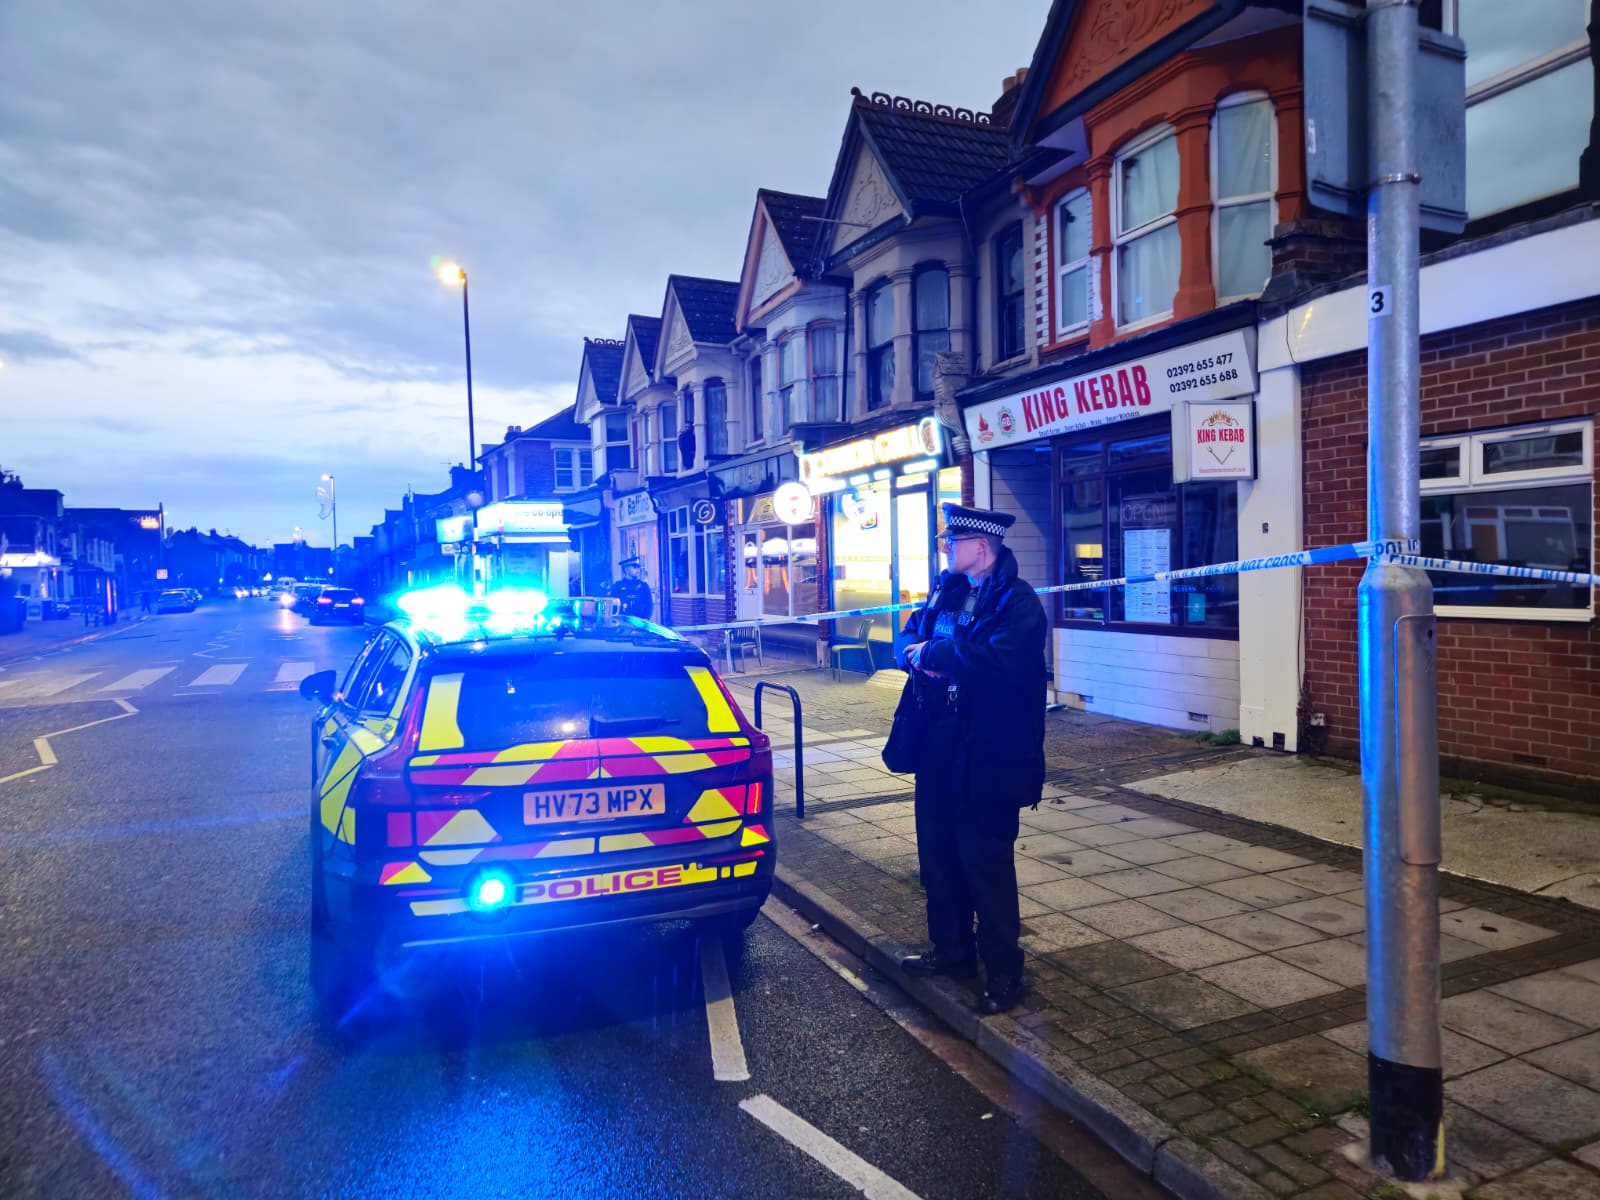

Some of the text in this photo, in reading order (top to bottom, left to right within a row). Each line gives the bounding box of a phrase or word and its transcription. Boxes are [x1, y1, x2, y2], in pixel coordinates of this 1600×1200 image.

[1371, 291, 1384, 313] 3
[1166, 352, 1233, 378] 02392 655 477
[1169, 368, 1238, 393] 02392 655 688
[1021, 387, 1069, 432] KING
[1073, 365, 1151, 414] KEBAB
[1197, 428, 1245, 443] KING KEBAB
[534, 788, 653, 819] HV73 MPX
[515, 866, 682, 903] POLICE
